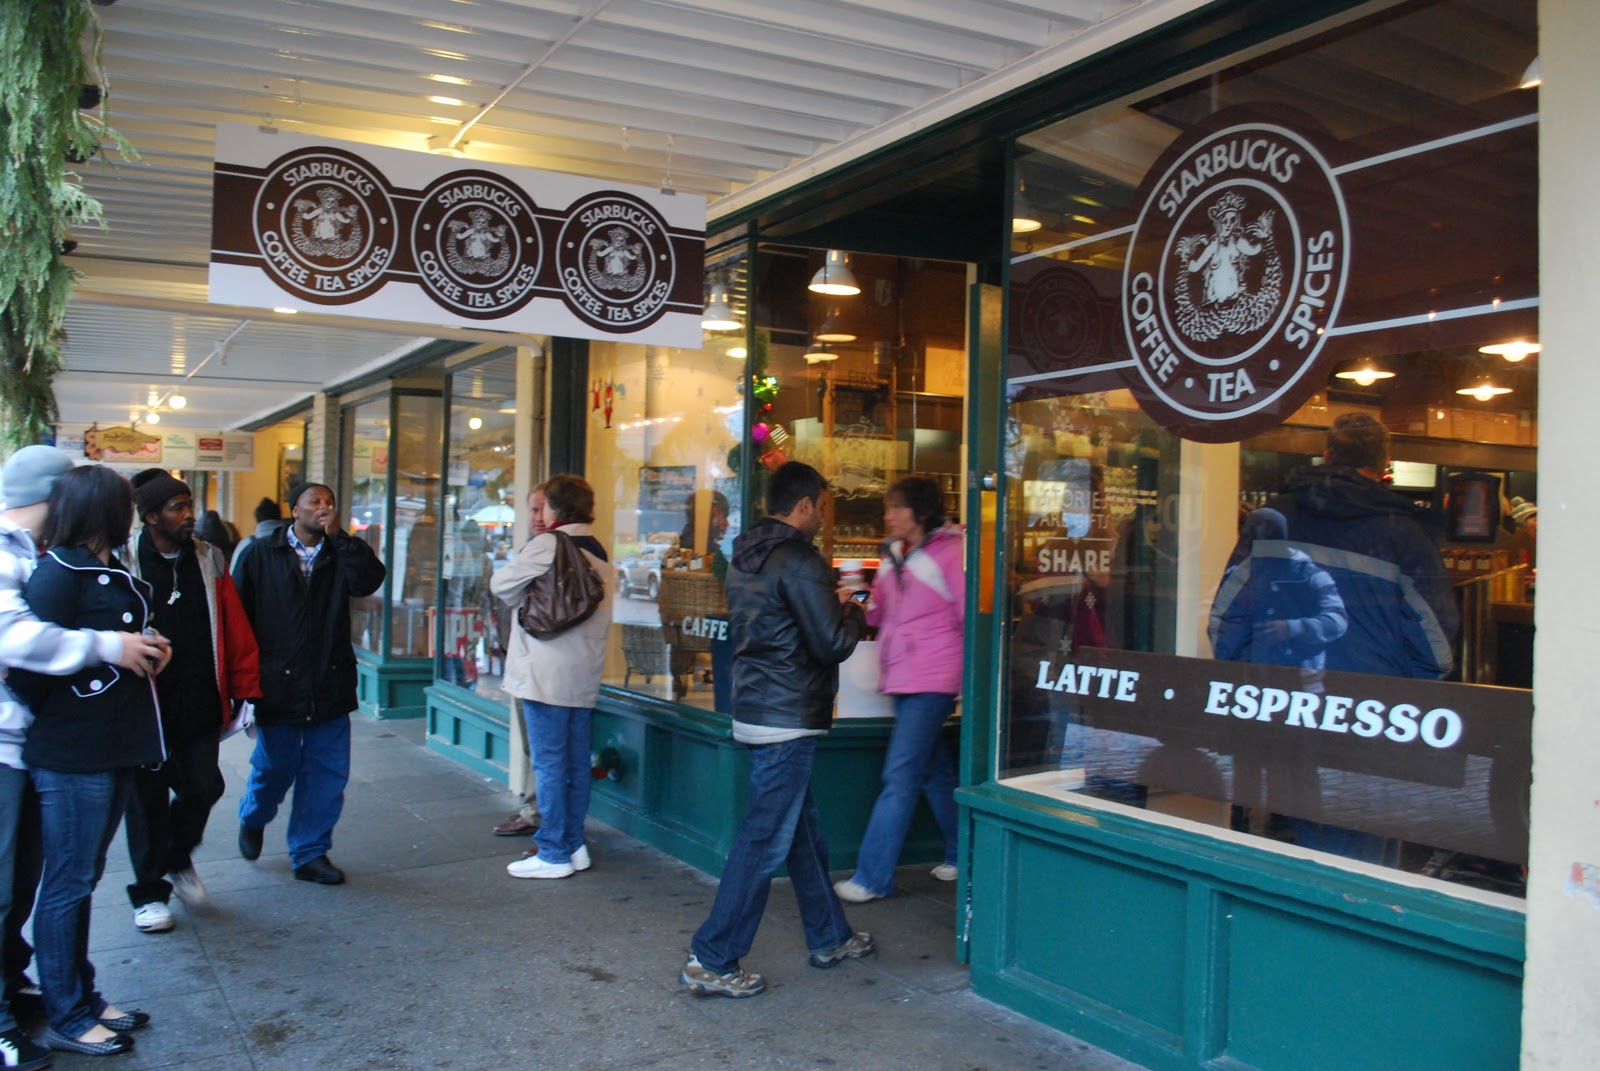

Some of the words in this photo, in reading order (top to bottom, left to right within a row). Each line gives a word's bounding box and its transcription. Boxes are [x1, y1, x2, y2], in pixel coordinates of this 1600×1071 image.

[282, 162, 375, 197] STARBUCKS
[437, 184, 522, 217] STARBUCKS
[1158, 138, 1301, 218] STARBUCKS
[580, 204, 657, 236] STARBUCKS
[262, 230, 310, 284] COFFEE
[314, 274, 346, 291] TEA
[346, 245, 389, 287] SPICES
[420, 250, 463, 301] COFFEE
[467, 291, 496, 307] TEA
[496, 263, 535, 303] SPICES
[564, 267, 604, 315] COFFEE
[606, 306, 633, 321] TEA
[633, 279, 668, 317] SPICES
[1131, 272, 1179, 383] COFFEE
[1207, 368, 1256, 402] TEA
[1285, 230, 1335, 350] SPICES
[1038, 548, 1111, 573] SHARE
[682, 615, 729, 641] CAFFE
[1035, 660, 1140, 702] LATTE
[1204, 681, 1463, 749] ESPRESSO
